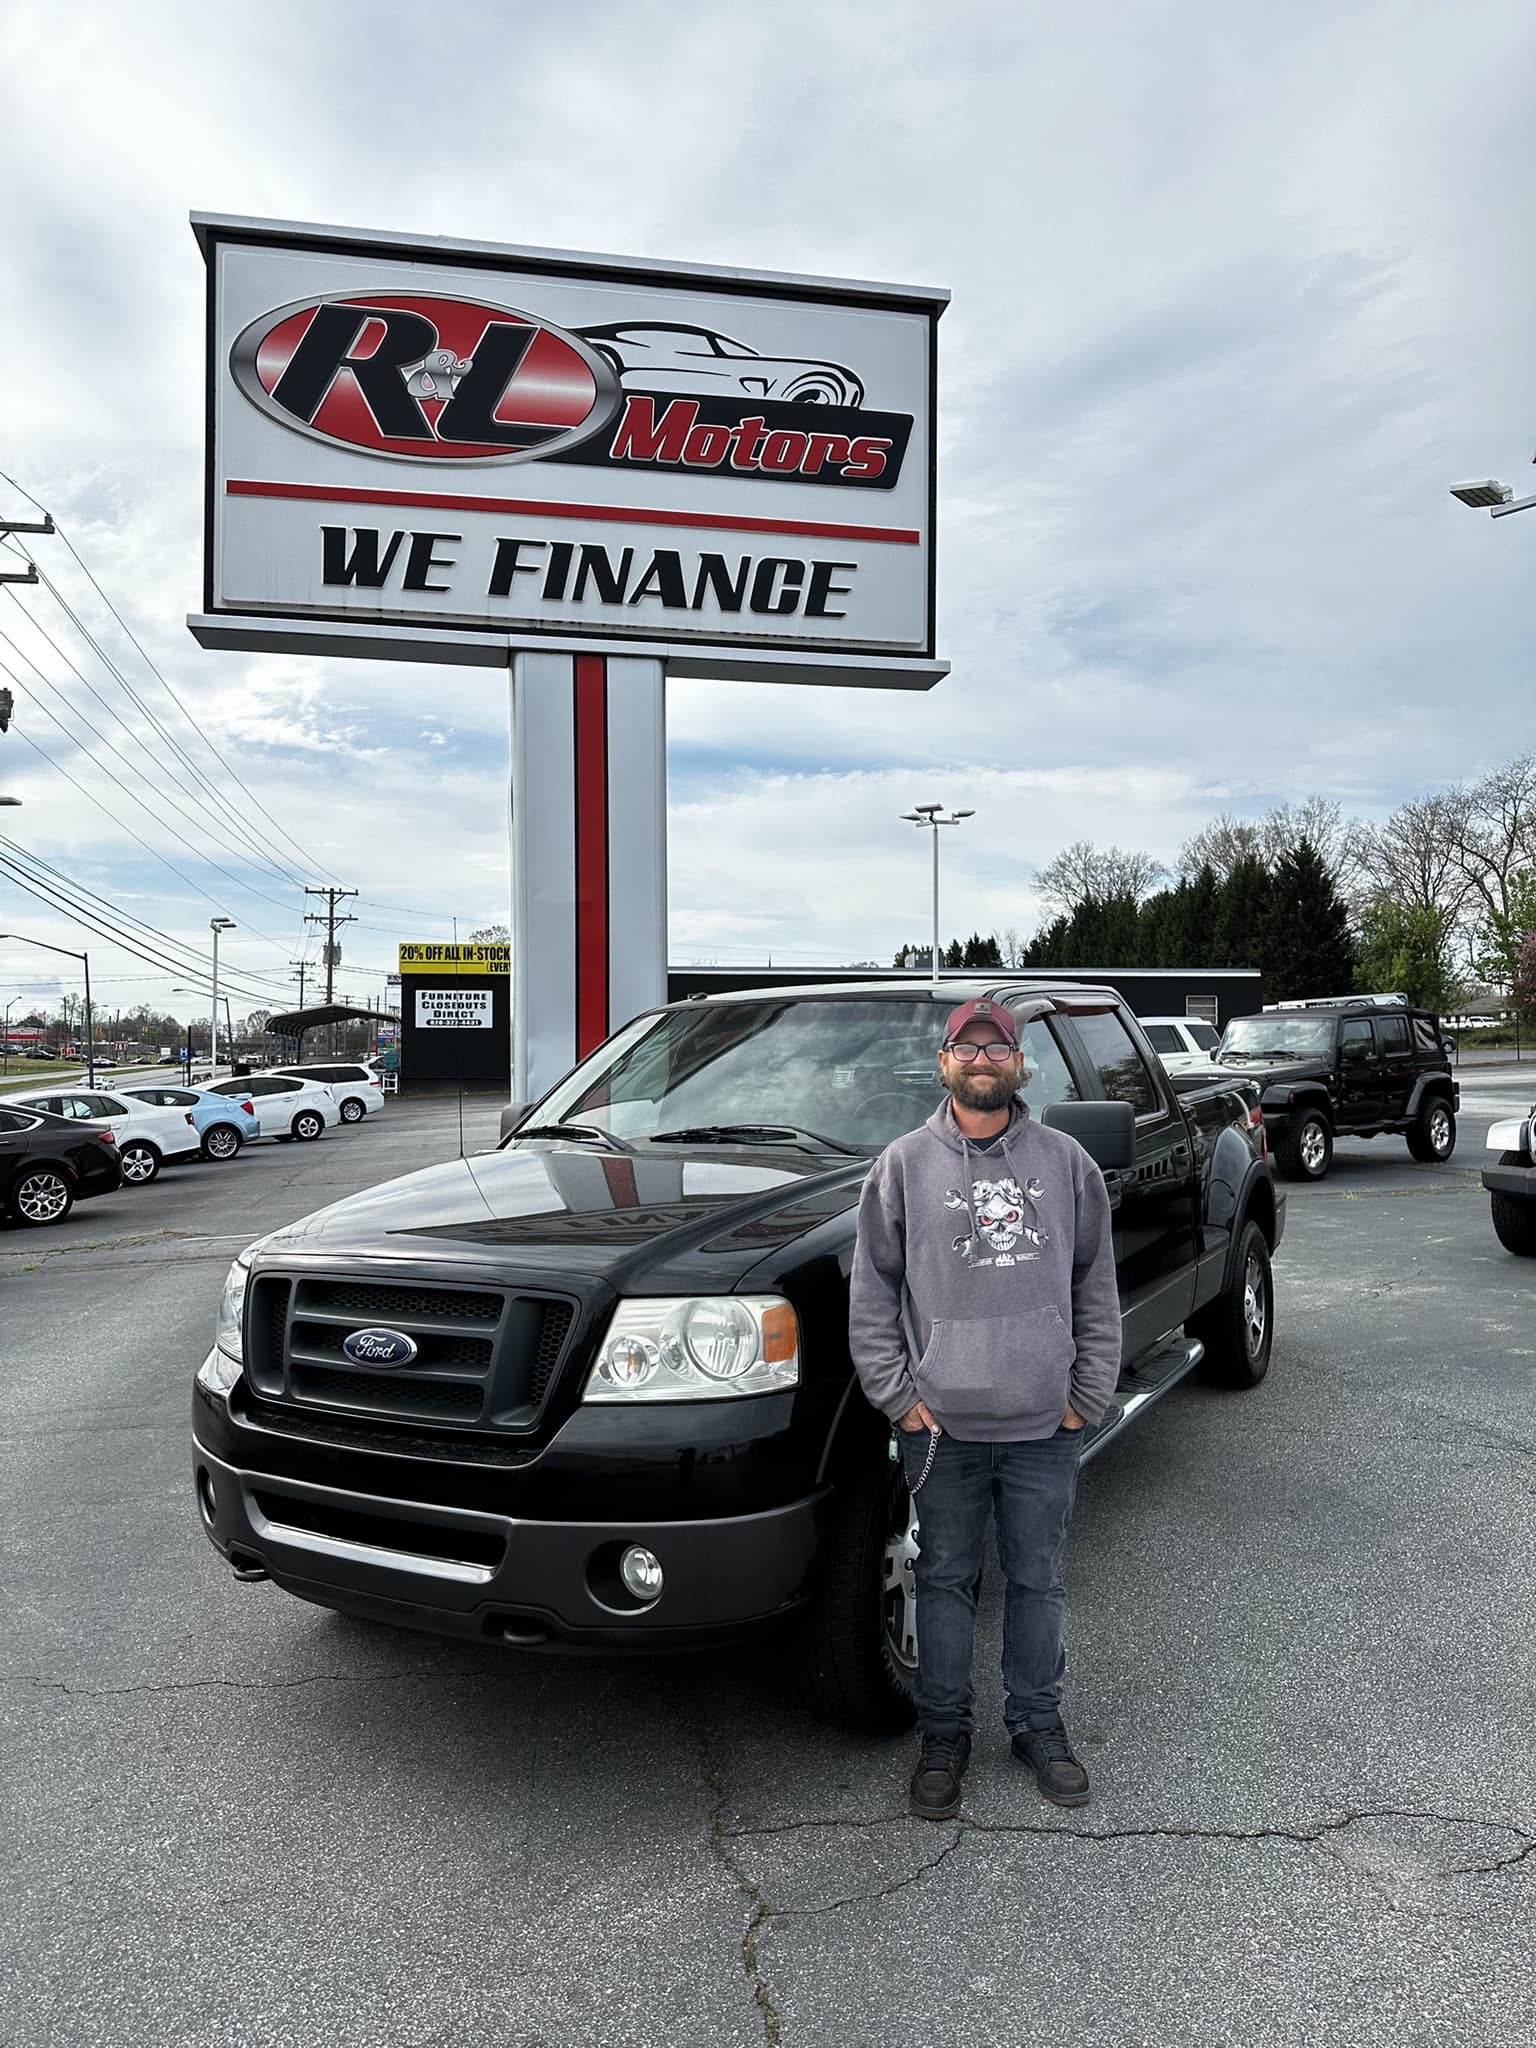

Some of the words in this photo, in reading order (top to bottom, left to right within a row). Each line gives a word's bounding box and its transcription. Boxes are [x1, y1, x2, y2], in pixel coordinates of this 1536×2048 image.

[269, 303, 577, 449] R&L
[610, 395, 893, 479] Motors
[319, 525, 462, 593] WE
[487, 537, 858, 618] FINANCE
[401, 946, 423, 960] 20%
[425, 946, 443, 961] OFF
[444, 946, 461, 961] ALL
[463, 946, 511, 961] IN-STOCK
[487, 962, 511, 973] (EVER
[421, 992, 487, 1000] FURNITURE
[422, 1001, 487, 1009] CLOSEOUTS
[433, 1010, 475, 1018] DIRECT
[355, 1335, 396, 1358] Ford
